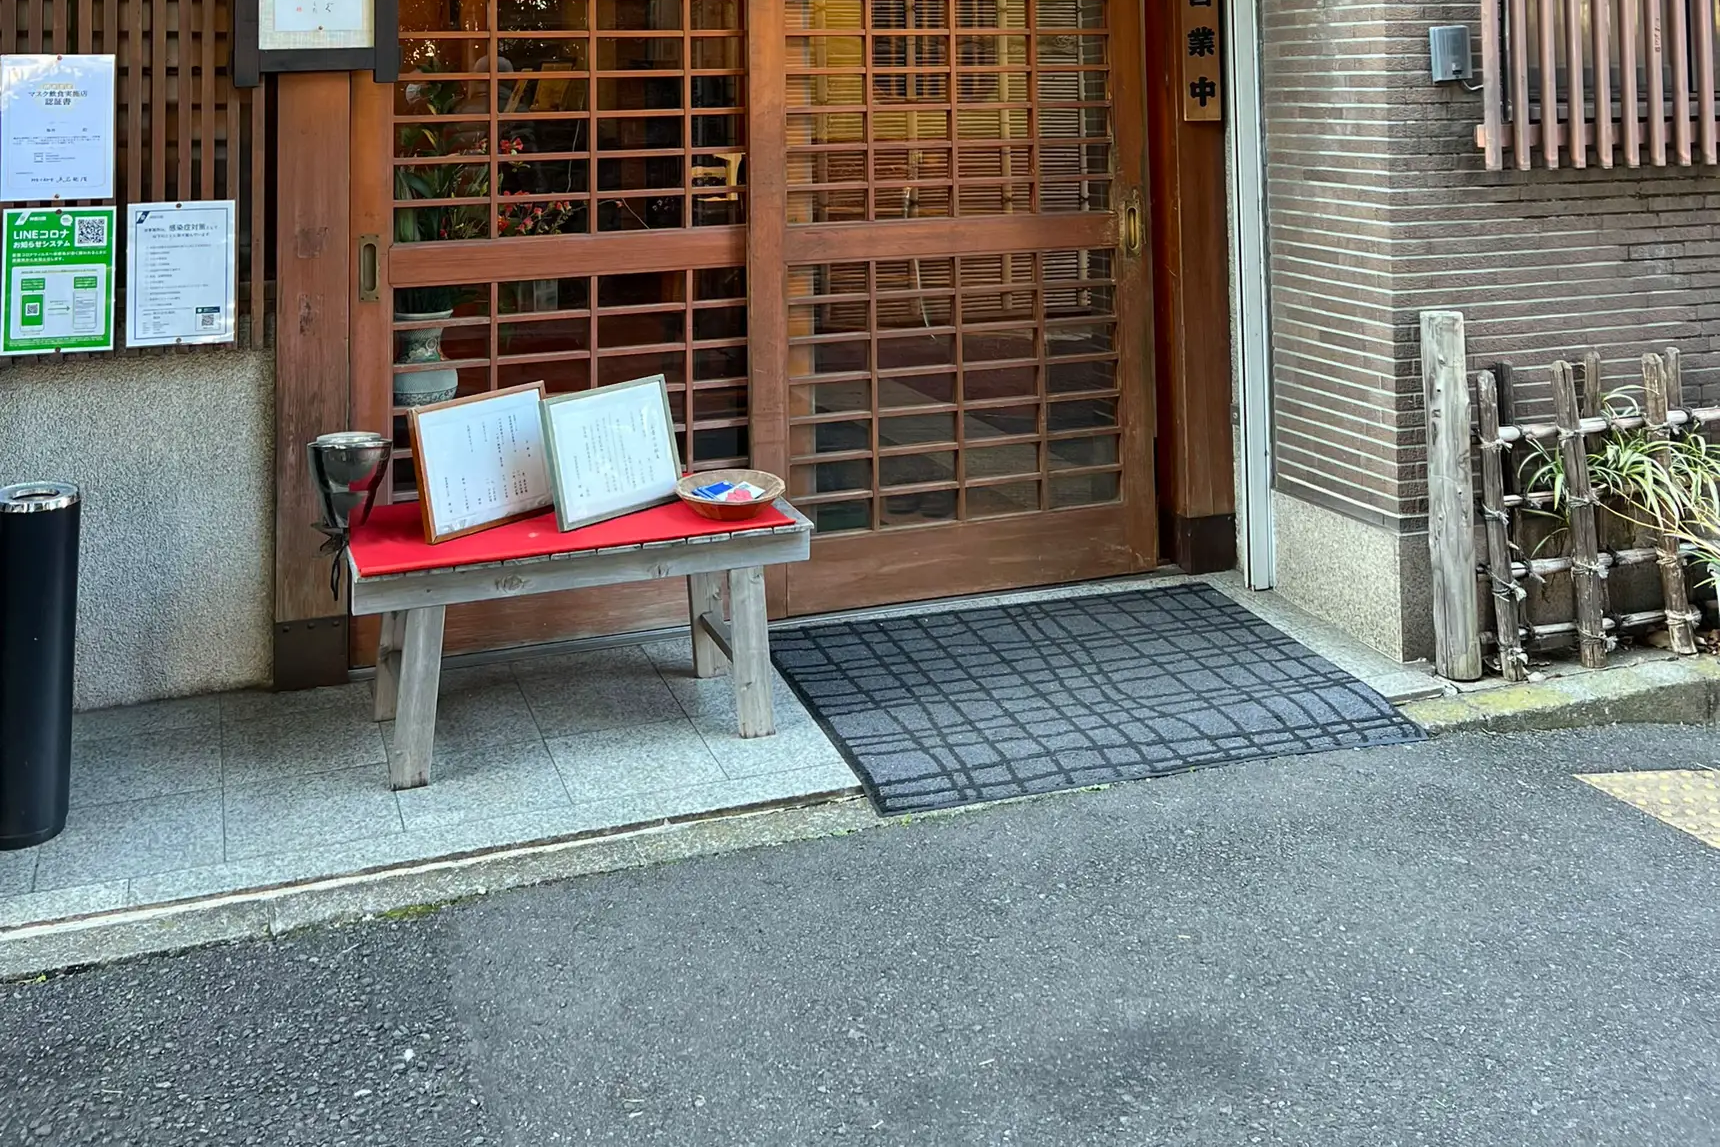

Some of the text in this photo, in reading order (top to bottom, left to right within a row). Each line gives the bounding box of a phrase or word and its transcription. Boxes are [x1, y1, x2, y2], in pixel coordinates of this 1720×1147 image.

[13, 230, 70, 240] LINEコロナ
[12, 240, 71, 249] お知らせシステム
